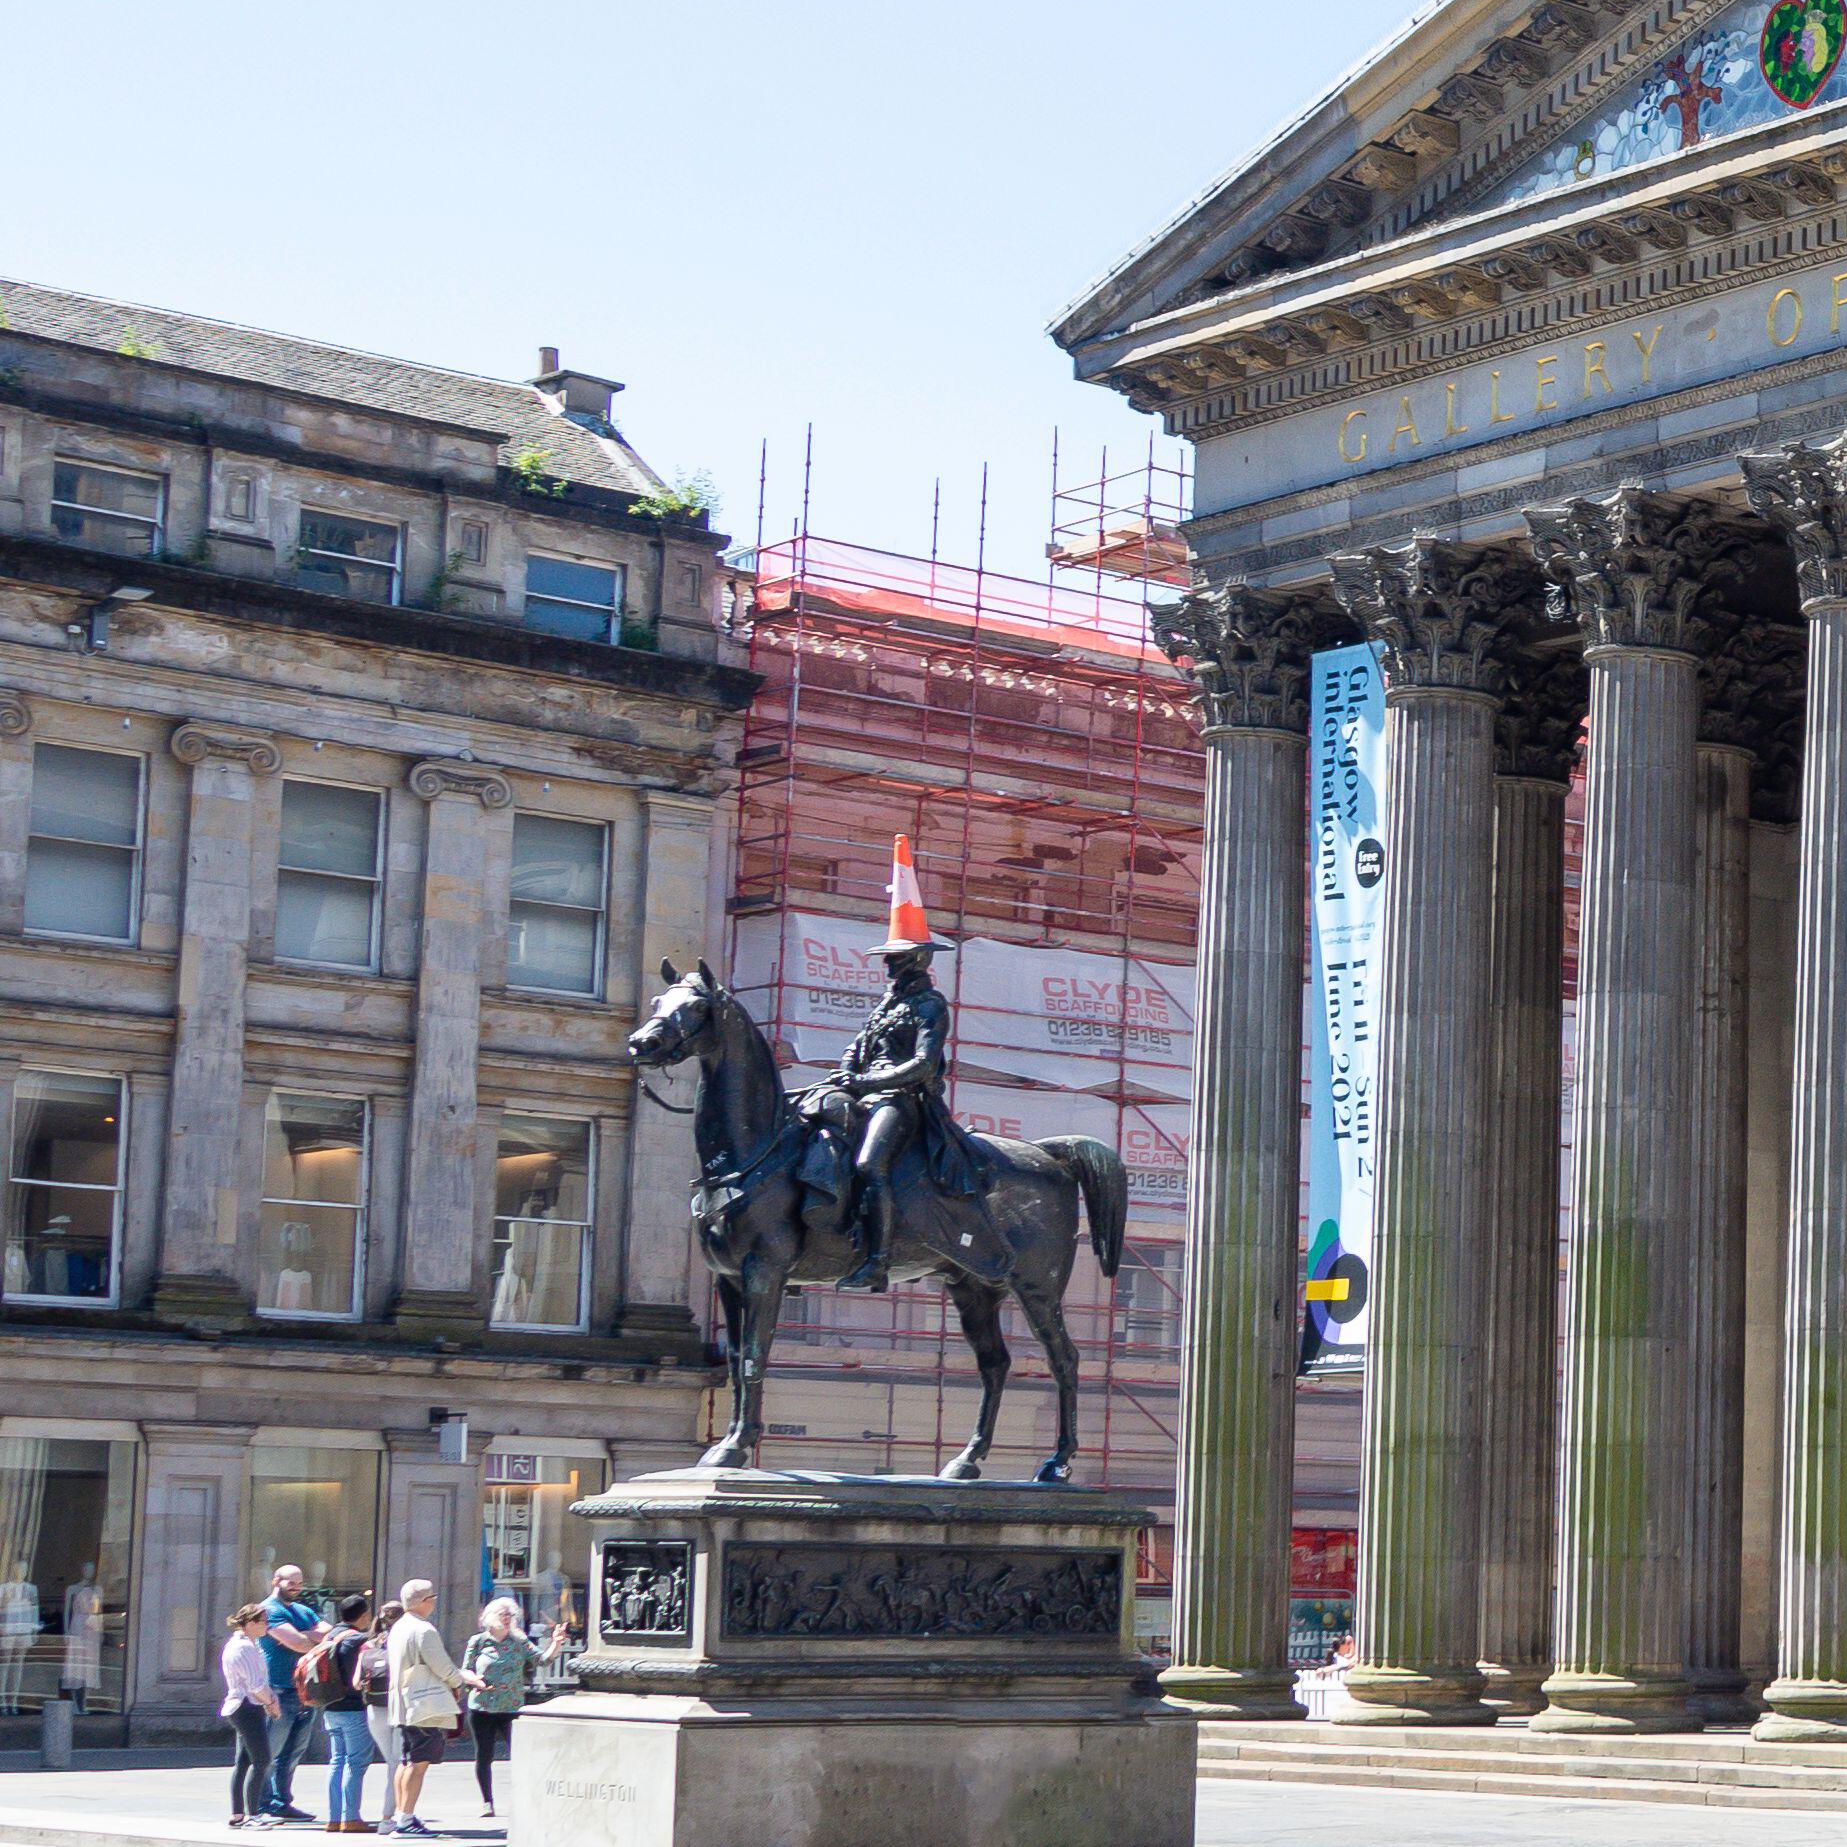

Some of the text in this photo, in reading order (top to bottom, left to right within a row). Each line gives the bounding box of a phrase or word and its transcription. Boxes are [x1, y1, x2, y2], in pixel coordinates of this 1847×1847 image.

[1338, 325, 1664, 463] GALLERY
[1338, 665, 1369, 825] Glasgow
[1321, 670, 1347, 901] international
[1357, 861, 1380, 876] Entry
[1358, 850, 1379, 862] Free
[803, 938, 888, 969] CLY
[1042, 977, 1168, 1010] CLYDE
[1045, 998, 1170, 1024] SCAFFOLDING
[1048, 1020, 1103, 1037] 01236
[1330, 1052, 1352, 1141] 2021
[1355, 1076, 1372, 1145] Sun
[1127, 1130, 1190, 1154] CLY
[546, 1779, 638, 1803] WELLINGTON
